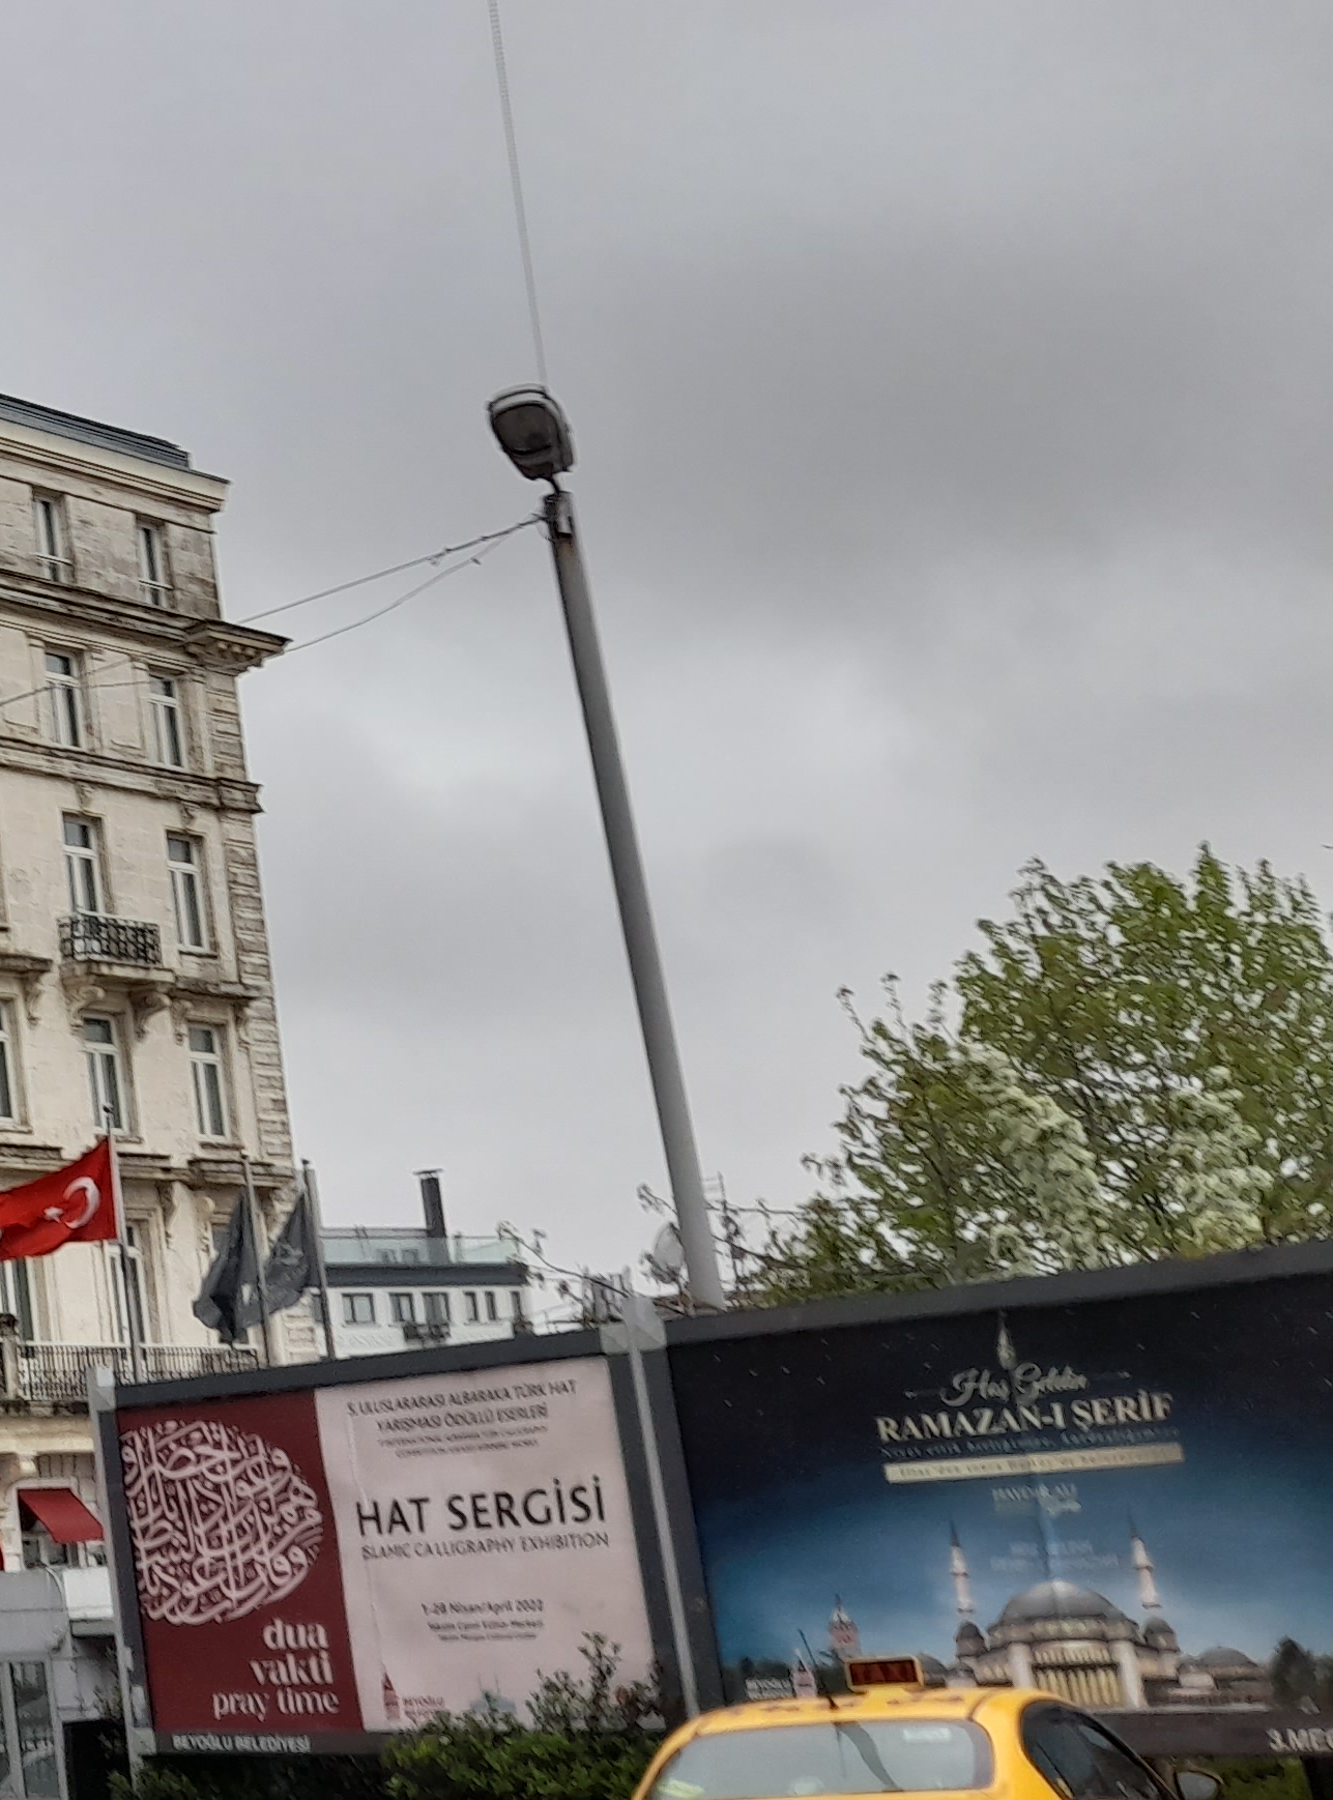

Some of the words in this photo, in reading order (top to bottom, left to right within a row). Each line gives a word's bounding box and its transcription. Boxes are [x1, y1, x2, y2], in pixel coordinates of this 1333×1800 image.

[548, 1378, 576, 1396] HAT
[1070, 1388, 1174, 1432] ŞERİF
[355, 1497, 431, 1537] HAT
[445, 1474, 606, 1532] SERGİSİ
[414, 1535, 517, 1558] CALLIGRAPHY
[520, 1531, 610, 1553] EXHIBITION
[262, 1616, 330, 1650] dua
[249, 1650, 334, 1686] vakti
[211, 1691, 270, 1723] pray
[277, 1685, 340, 1715] time
